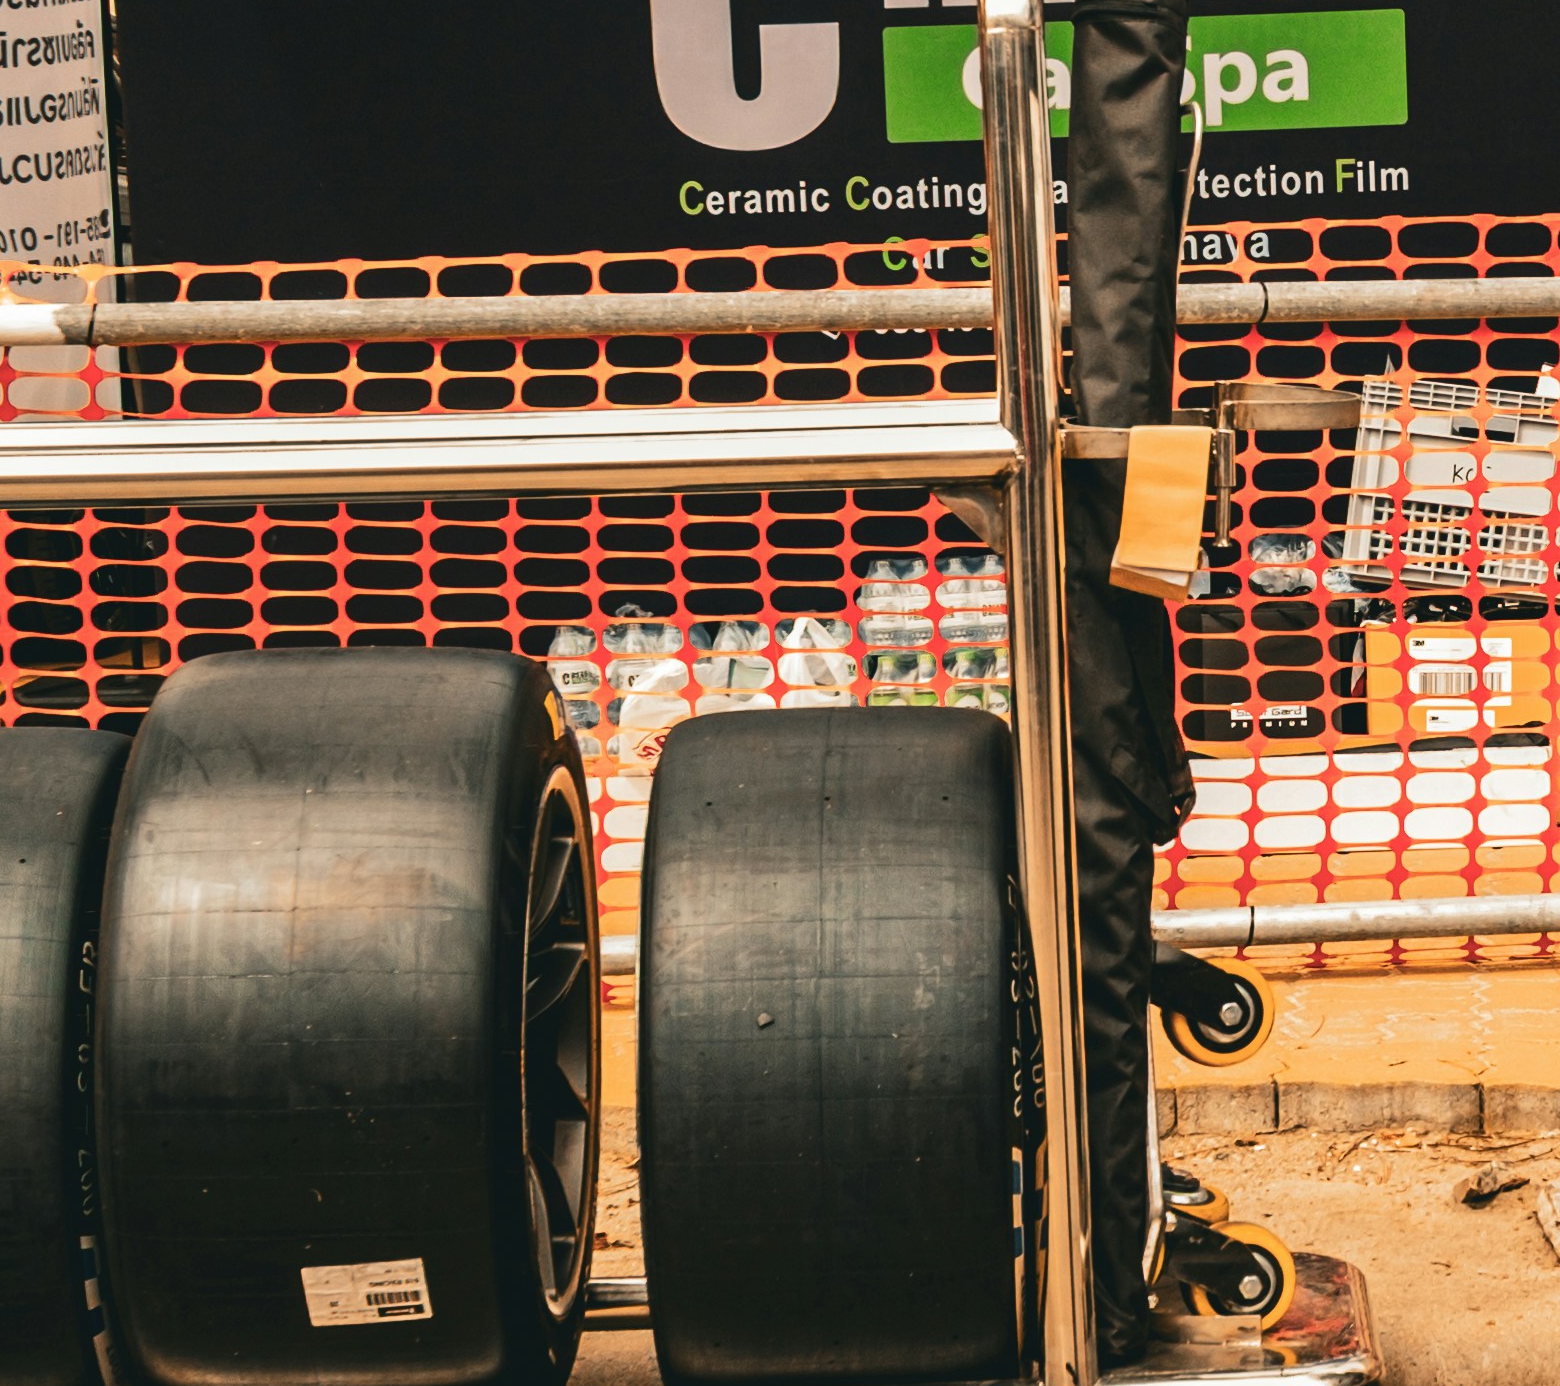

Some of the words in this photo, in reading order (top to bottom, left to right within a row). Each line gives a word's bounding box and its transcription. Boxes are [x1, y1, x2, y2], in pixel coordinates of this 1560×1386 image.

[1181, 35, 1310, 127] pa
[679, 180, 830, 215] Ceramic
[845, 175, 987, 215] Coating
[1196, 164, 1324, 199] tection
[1336, 158, 1409, 193] Film
